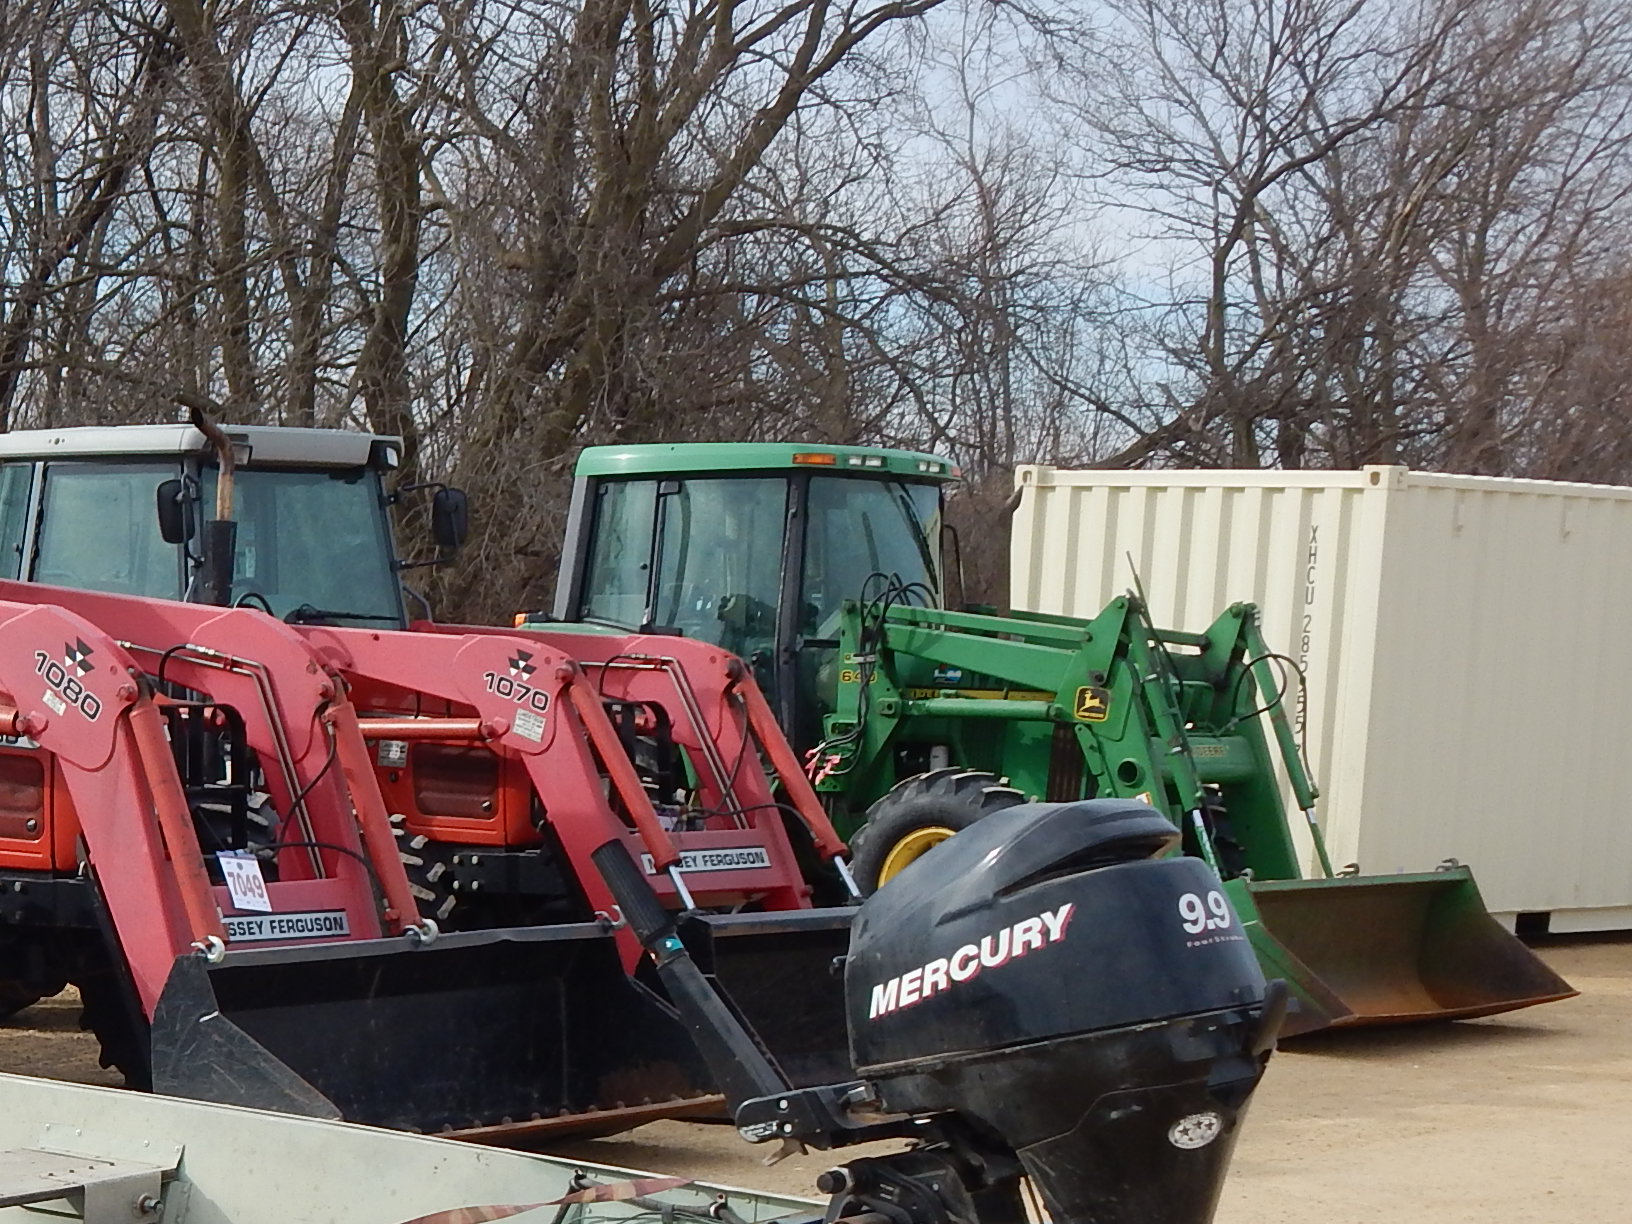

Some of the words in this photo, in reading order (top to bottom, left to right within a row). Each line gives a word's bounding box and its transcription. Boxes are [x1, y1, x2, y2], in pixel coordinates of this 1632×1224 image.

[1305, 524, 1319, 606] XHCU
[35, 650, 102, 722] 1080
[483, 670, 550, 713] 1070
[702, 851, 765, 866] FERGUSON
[228, 871, 265, 899] 7049
[269, 916, 344, 934] FERGUSON
[1178, 890, 1230, 934] 9.9
[869, 902, 1076, 1020] MERCURY
